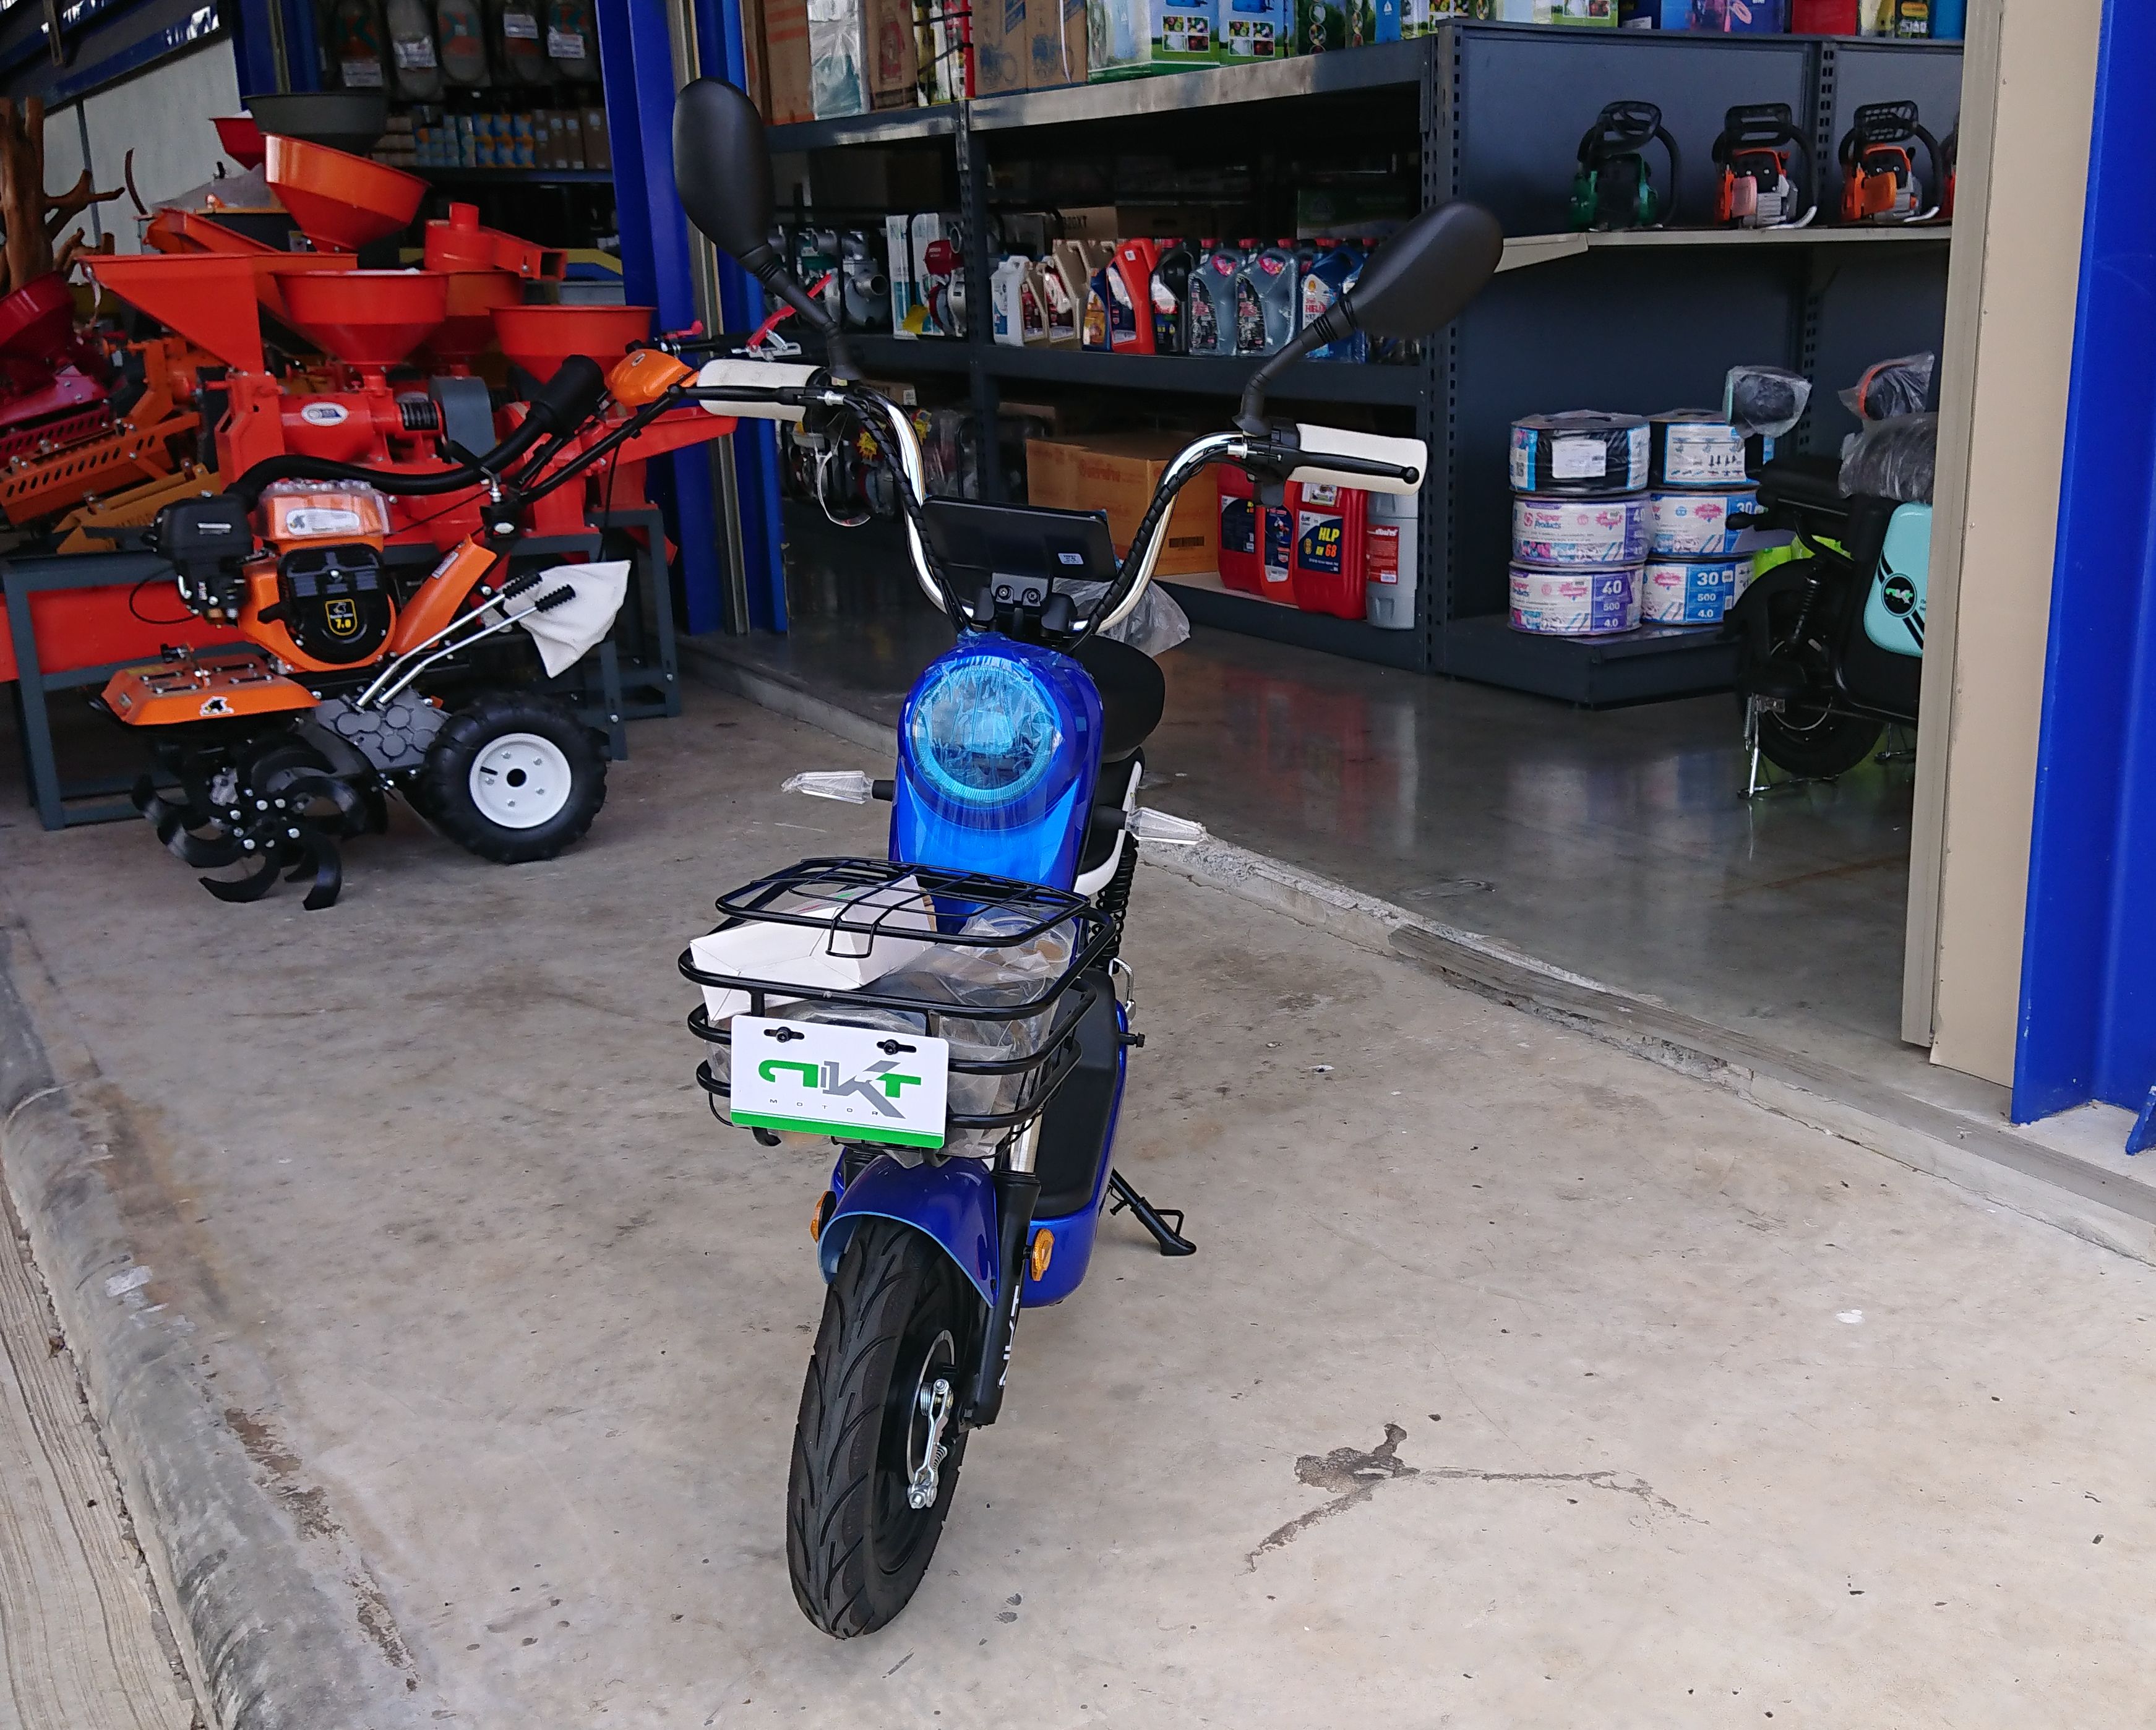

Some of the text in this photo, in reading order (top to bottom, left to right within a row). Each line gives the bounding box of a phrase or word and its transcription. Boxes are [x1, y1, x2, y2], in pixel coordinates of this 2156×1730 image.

[1536, 512, 1561, 521] Super
[1318, 526, 1340, 542] HLP
[1325, 543, 1338, 558] 68
[1697, 572, 1719, 586] 30
[1602, 580, 1622, 594] 40
[1697, 593, 1716, 602] 500
[1603, 602, 1620, 611] 500
[1698, 609, 1714, 618] 4.0
[335, 619, 351, 629] 7.0
[1604, 618, 1618, 627] 4.0
[770, 1098, 878, 1116] MOTOR
